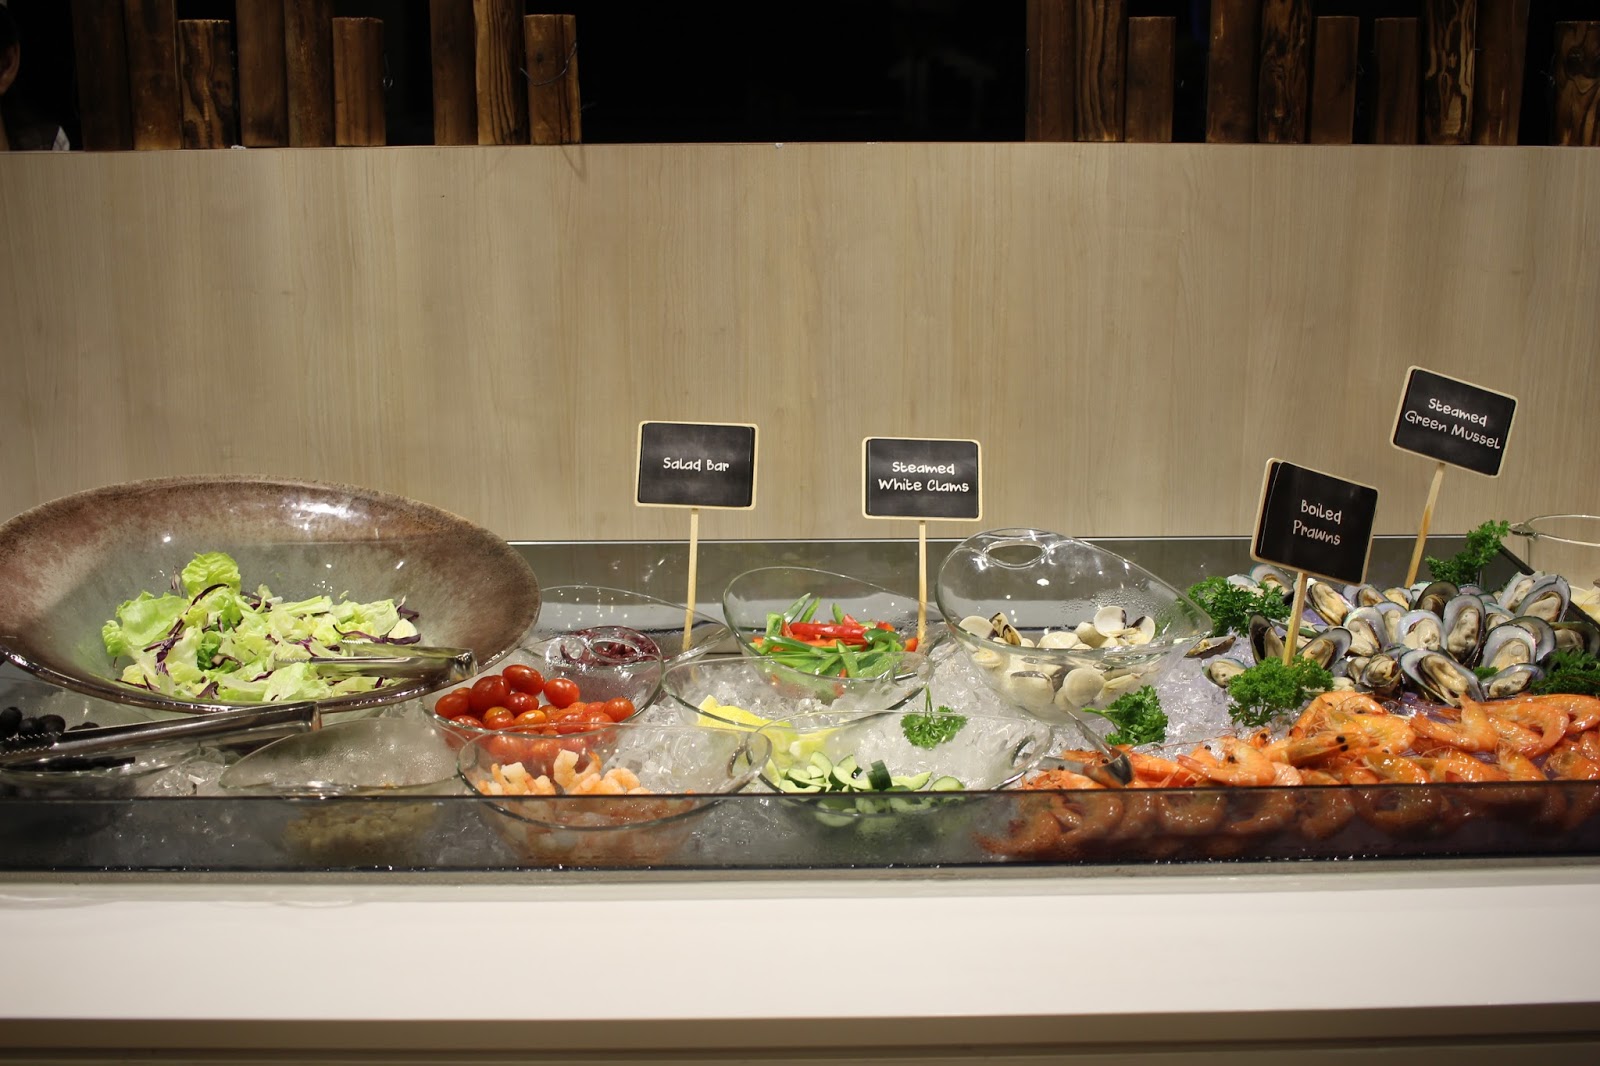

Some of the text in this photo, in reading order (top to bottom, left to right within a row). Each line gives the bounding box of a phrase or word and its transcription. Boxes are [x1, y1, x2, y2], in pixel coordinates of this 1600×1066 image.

[1428, 398, 1488, 428] Steamed
[1405, 410, 1501, 450] Green Mussel
[662, 457, 730, 473] Salad Bar
[891, 461, 956, 476] Steamed
[877, 478, 970, 493] White Clams
[1300, 499, 1342, 525] Boiled
[1292, 519, 1341, 546] Prawns
